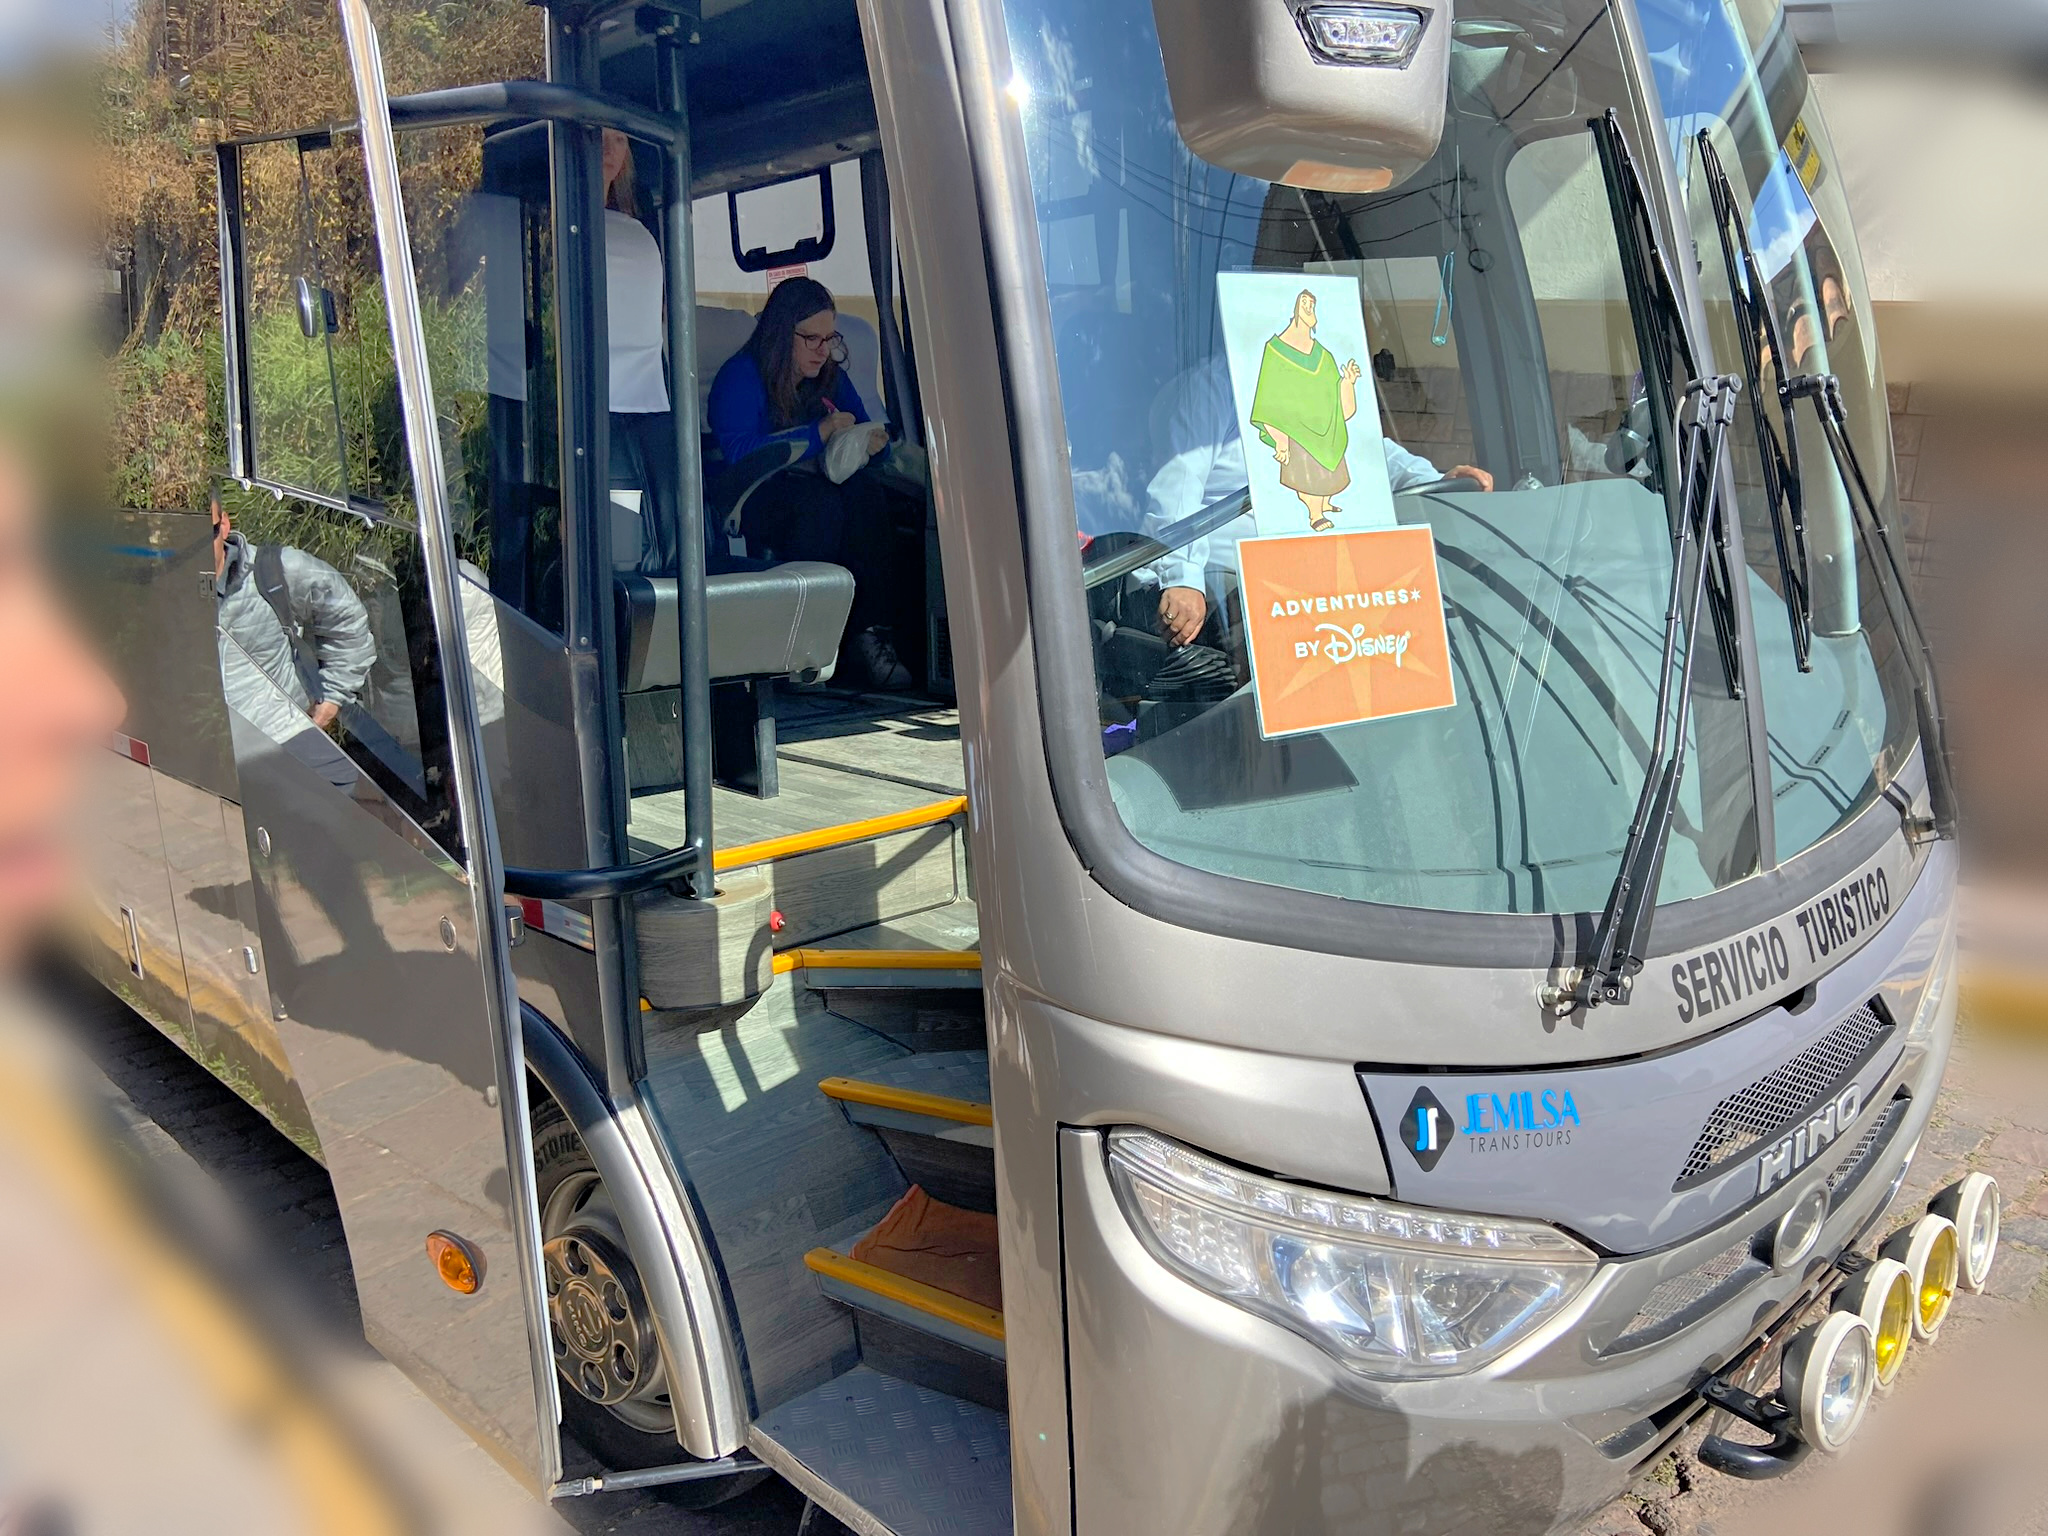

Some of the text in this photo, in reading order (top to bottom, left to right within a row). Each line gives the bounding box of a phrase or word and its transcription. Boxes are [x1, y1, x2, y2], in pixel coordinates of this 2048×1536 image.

[1271, 589, 1409, 617] ADVENTURES
[1295, 640, 1320, 660] BY
[1671, 866, 1890, 1024] SERVICIO TURISTICO
[1469, 1129, 1572, 1154] TRANS TOURS
[1757, 1082, 1861, 1196] HINO
